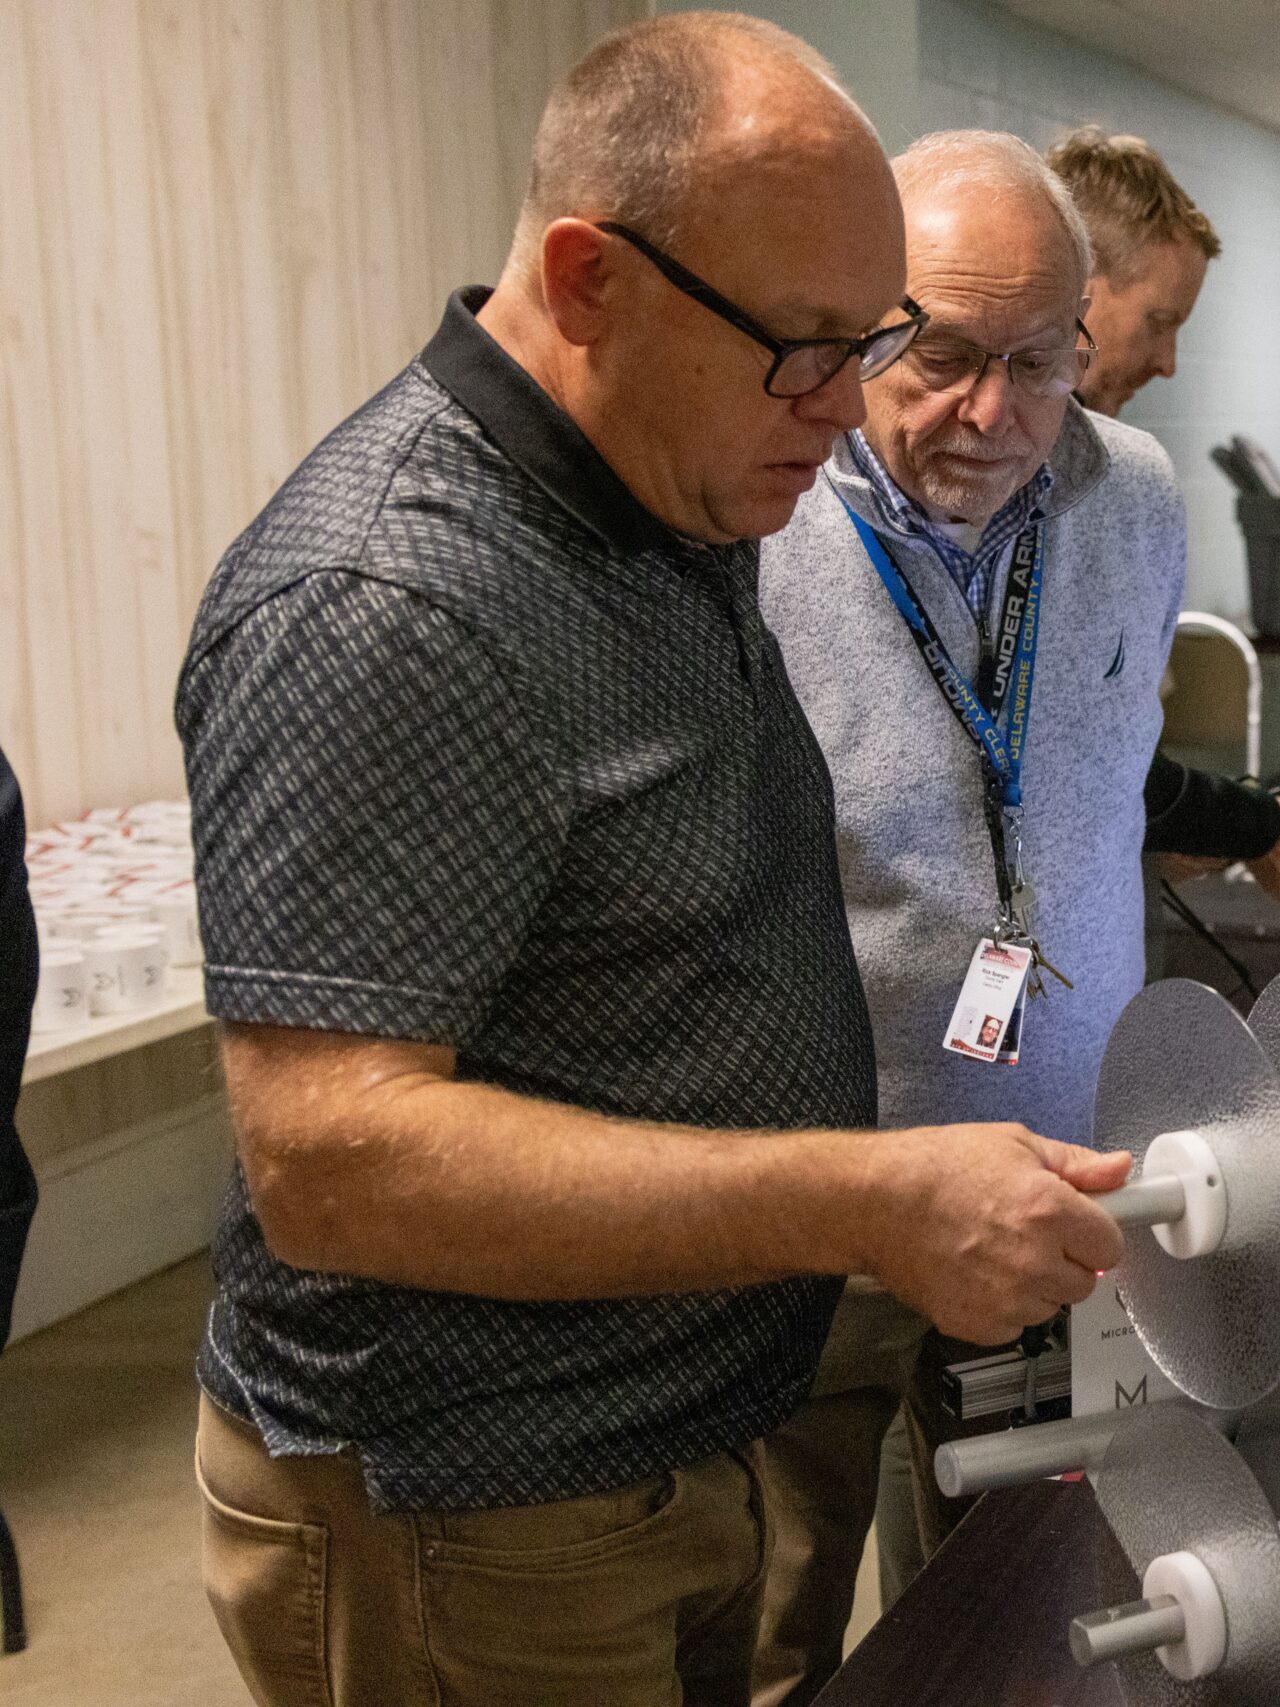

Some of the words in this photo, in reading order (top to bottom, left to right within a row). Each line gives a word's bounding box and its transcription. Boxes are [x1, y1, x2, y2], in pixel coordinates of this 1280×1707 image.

[992, 596, 1024, 698] UNDER
[1022, 578, 1039, 652] COUNTY
[1101, 1325, 1136, 1340] MICRO
